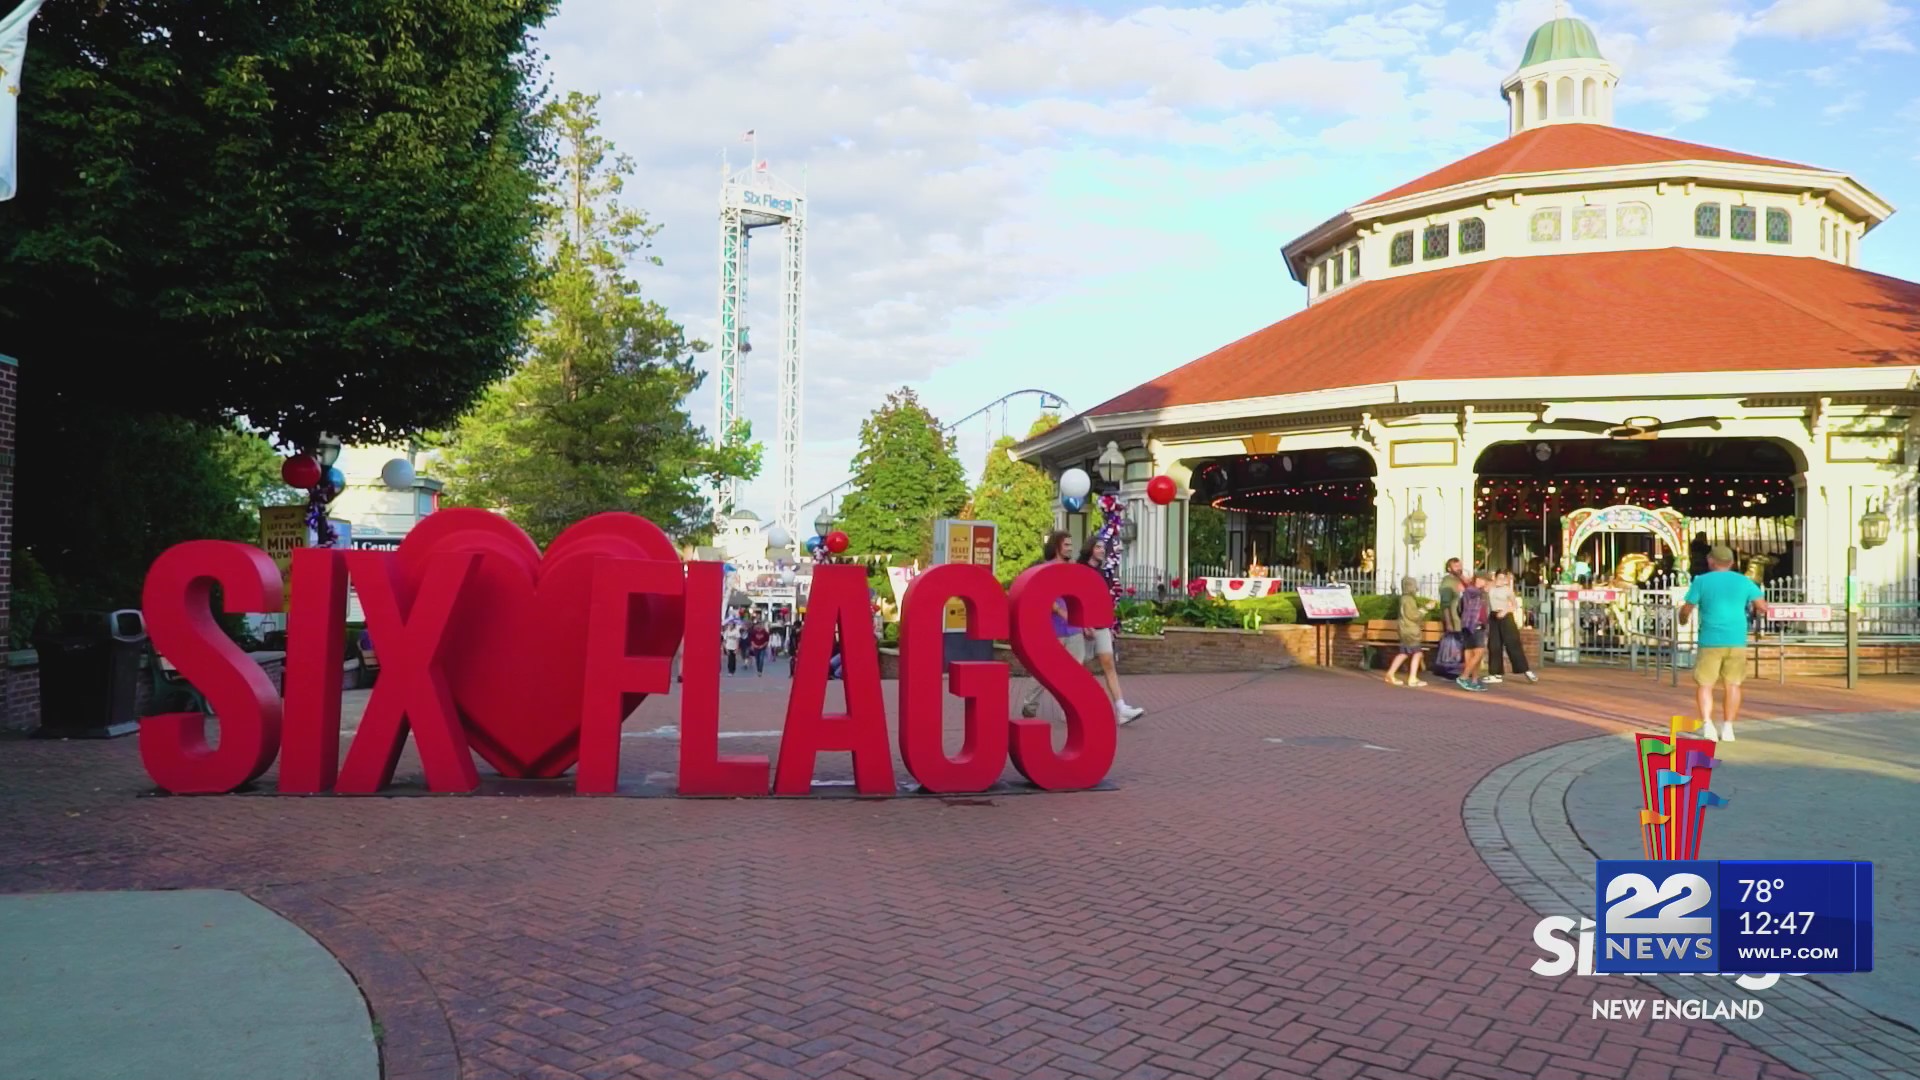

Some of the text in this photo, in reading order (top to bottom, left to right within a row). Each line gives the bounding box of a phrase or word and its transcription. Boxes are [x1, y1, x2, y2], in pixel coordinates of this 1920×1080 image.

[743, 190, 793, 213] Six Flags
[267, 536, 304, 551] MIND
[139, 540, 1117, 797] SIX FLAGS
